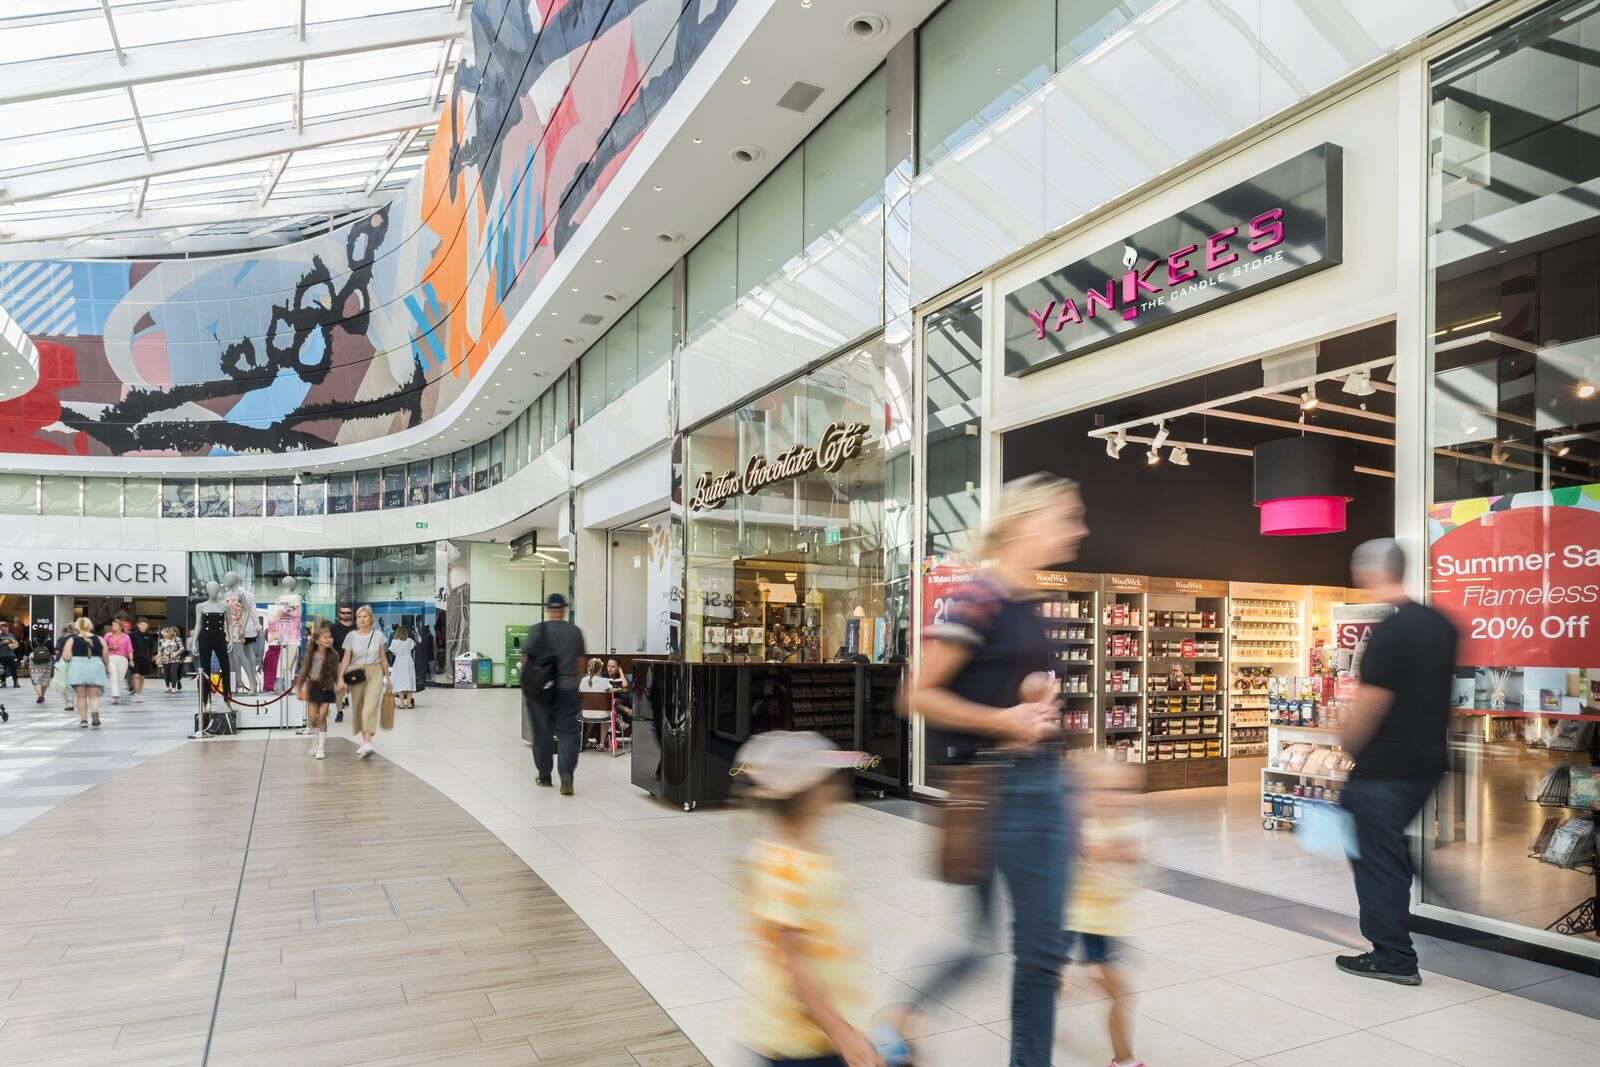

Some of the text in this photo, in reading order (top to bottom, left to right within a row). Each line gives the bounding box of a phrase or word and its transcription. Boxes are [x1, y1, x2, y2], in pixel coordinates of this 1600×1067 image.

[1027, 206, 1286, 340] YANKEES
[1140, 250, 1284, 313] THE CANDLE STORE
[689, 421, 870, 511] Butlers Chocolate Café
[11, 561, 30, 581] &
[36, 561, 168, 583] SPENCER
[1437, 551, 1555, 577] Summer
[1112, 576, 1142, 586] WoodWick
[1175, 580, 1203, 590] WoodWick
[1463, 584, 1598, 607] Flameless
[1471, 614, 1590, 639] 20% Off
